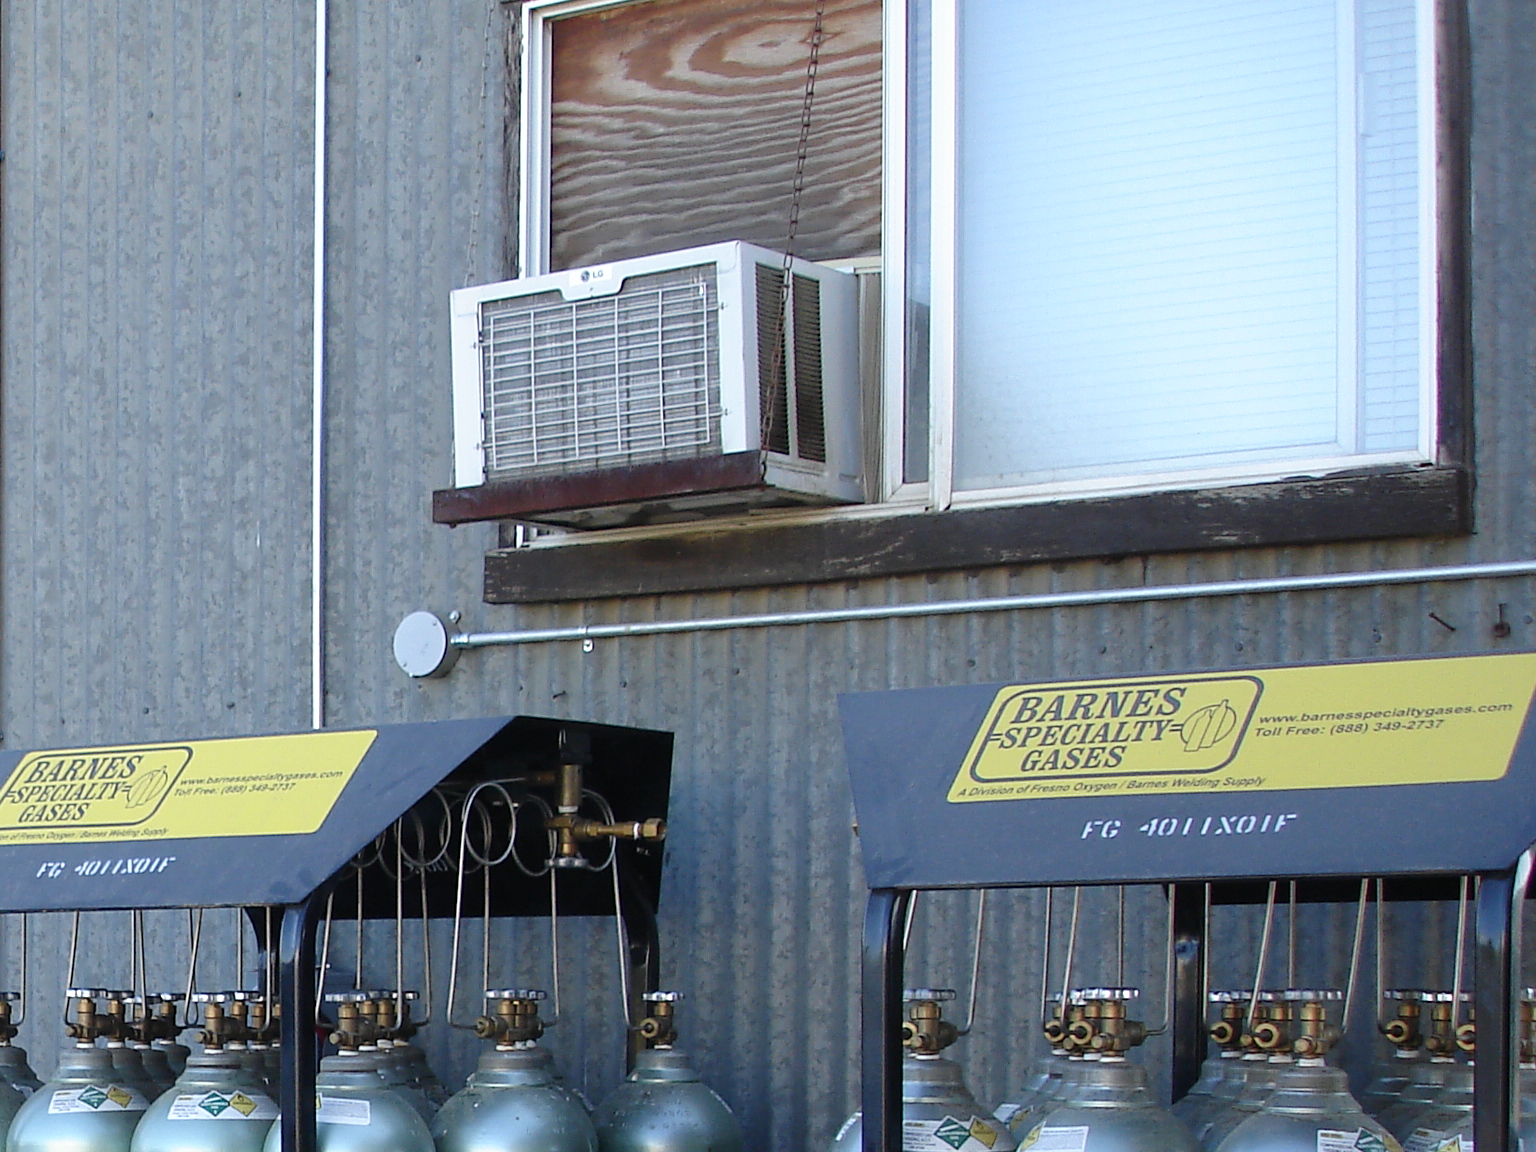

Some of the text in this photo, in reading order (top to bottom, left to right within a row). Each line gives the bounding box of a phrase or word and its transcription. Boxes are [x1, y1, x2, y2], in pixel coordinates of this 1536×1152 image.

[592, 269, 604, 279] LG
[1010, 687, 1187, 724] BARNES
[1259, 703, 1513, 724] www.barnesspecialtygases.com
[999, 719, 1174, 749] SPECIALTY
[1255, 719, 1445, 737] Toll Free: (888) 349-2737
[1021, 745, 1128, 772] GASES
[24, 755, 144, 784] BARNES
[181, 770, 343, 786] www.barnesspecialtygases.com
[10, 781, 128, 804] SPECIALTY
[957, 788, 968, 797] A
[968, 787, 1014, 797] Division
[1016, 784, 1031, 795] of
[1030, 784, 1070, 793] Fresno
[1073, 782, 1117, 793] Oxygen
[1126, 780, 1167, 789] Barnes
[1171, 778, 1220, 788] Welding
[1222, 776, 1266, 787] Supply
[18, 802, 91, 823] GASES
[1080, 820, 1121, 839] FG
